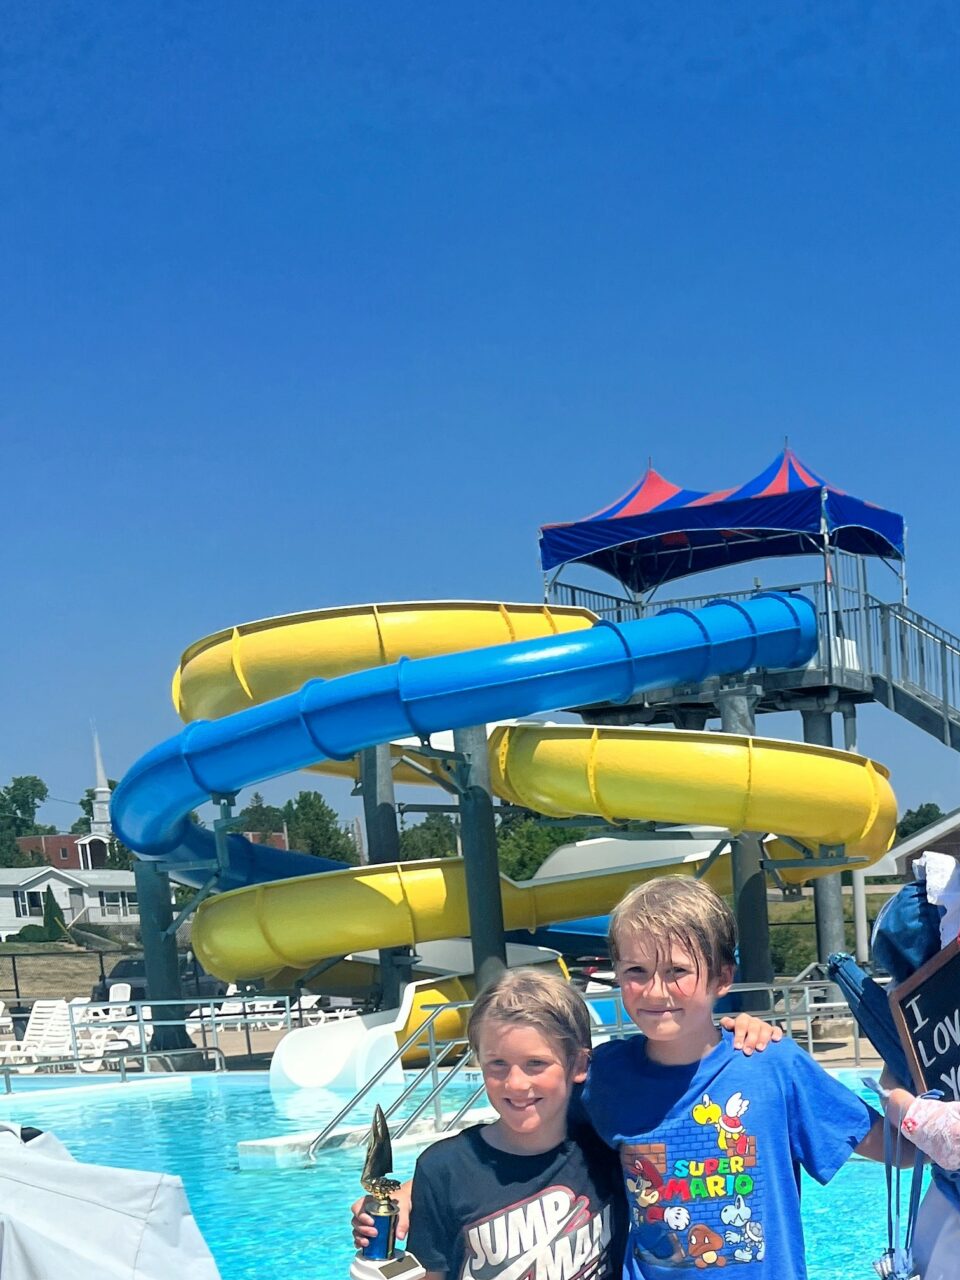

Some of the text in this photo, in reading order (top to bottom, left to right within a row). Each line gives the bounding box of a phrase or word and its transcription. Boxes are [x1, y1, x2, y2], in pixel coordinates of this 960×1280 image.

[905, 994, 929, 1033] I
[673, 1156, 745, 1178] SUPER
[664, 1174, 754, 1200] MARIO
[468, 1190, 571, 1271] JUMP
